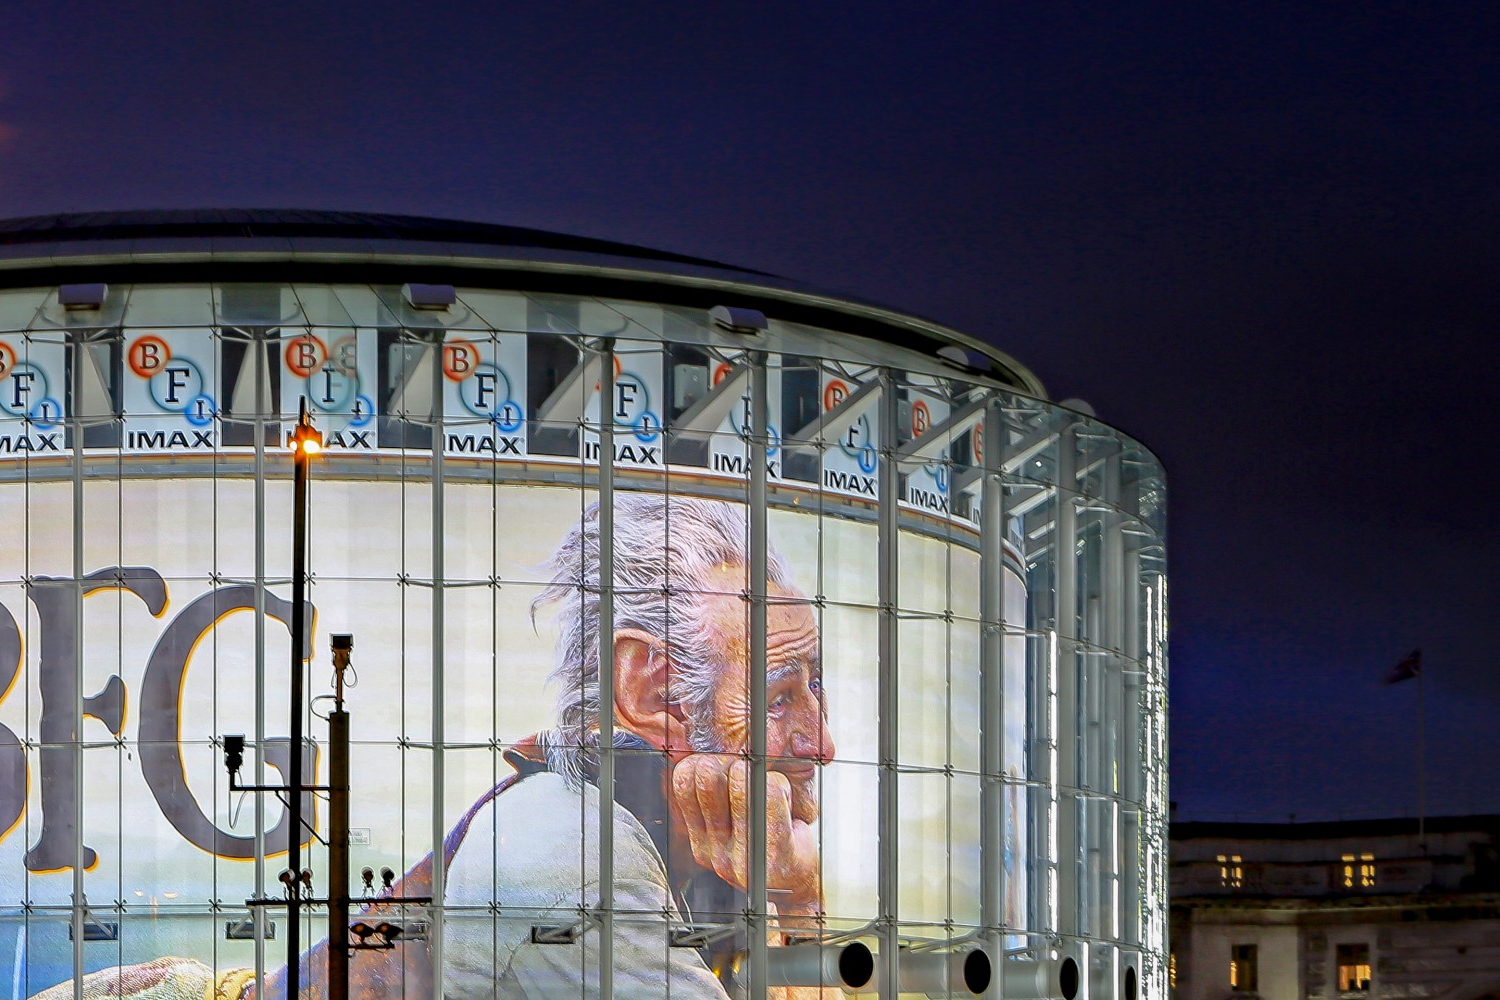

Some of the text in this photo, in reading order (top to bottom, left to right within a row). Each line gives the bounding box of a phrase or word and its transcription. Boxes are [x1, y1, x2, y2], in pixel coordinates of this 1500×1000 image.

[128, 430, 215, 450] IMAX
[823, 469, 877, 497] IMAX
[910, 487, 949, 515] IMAX
